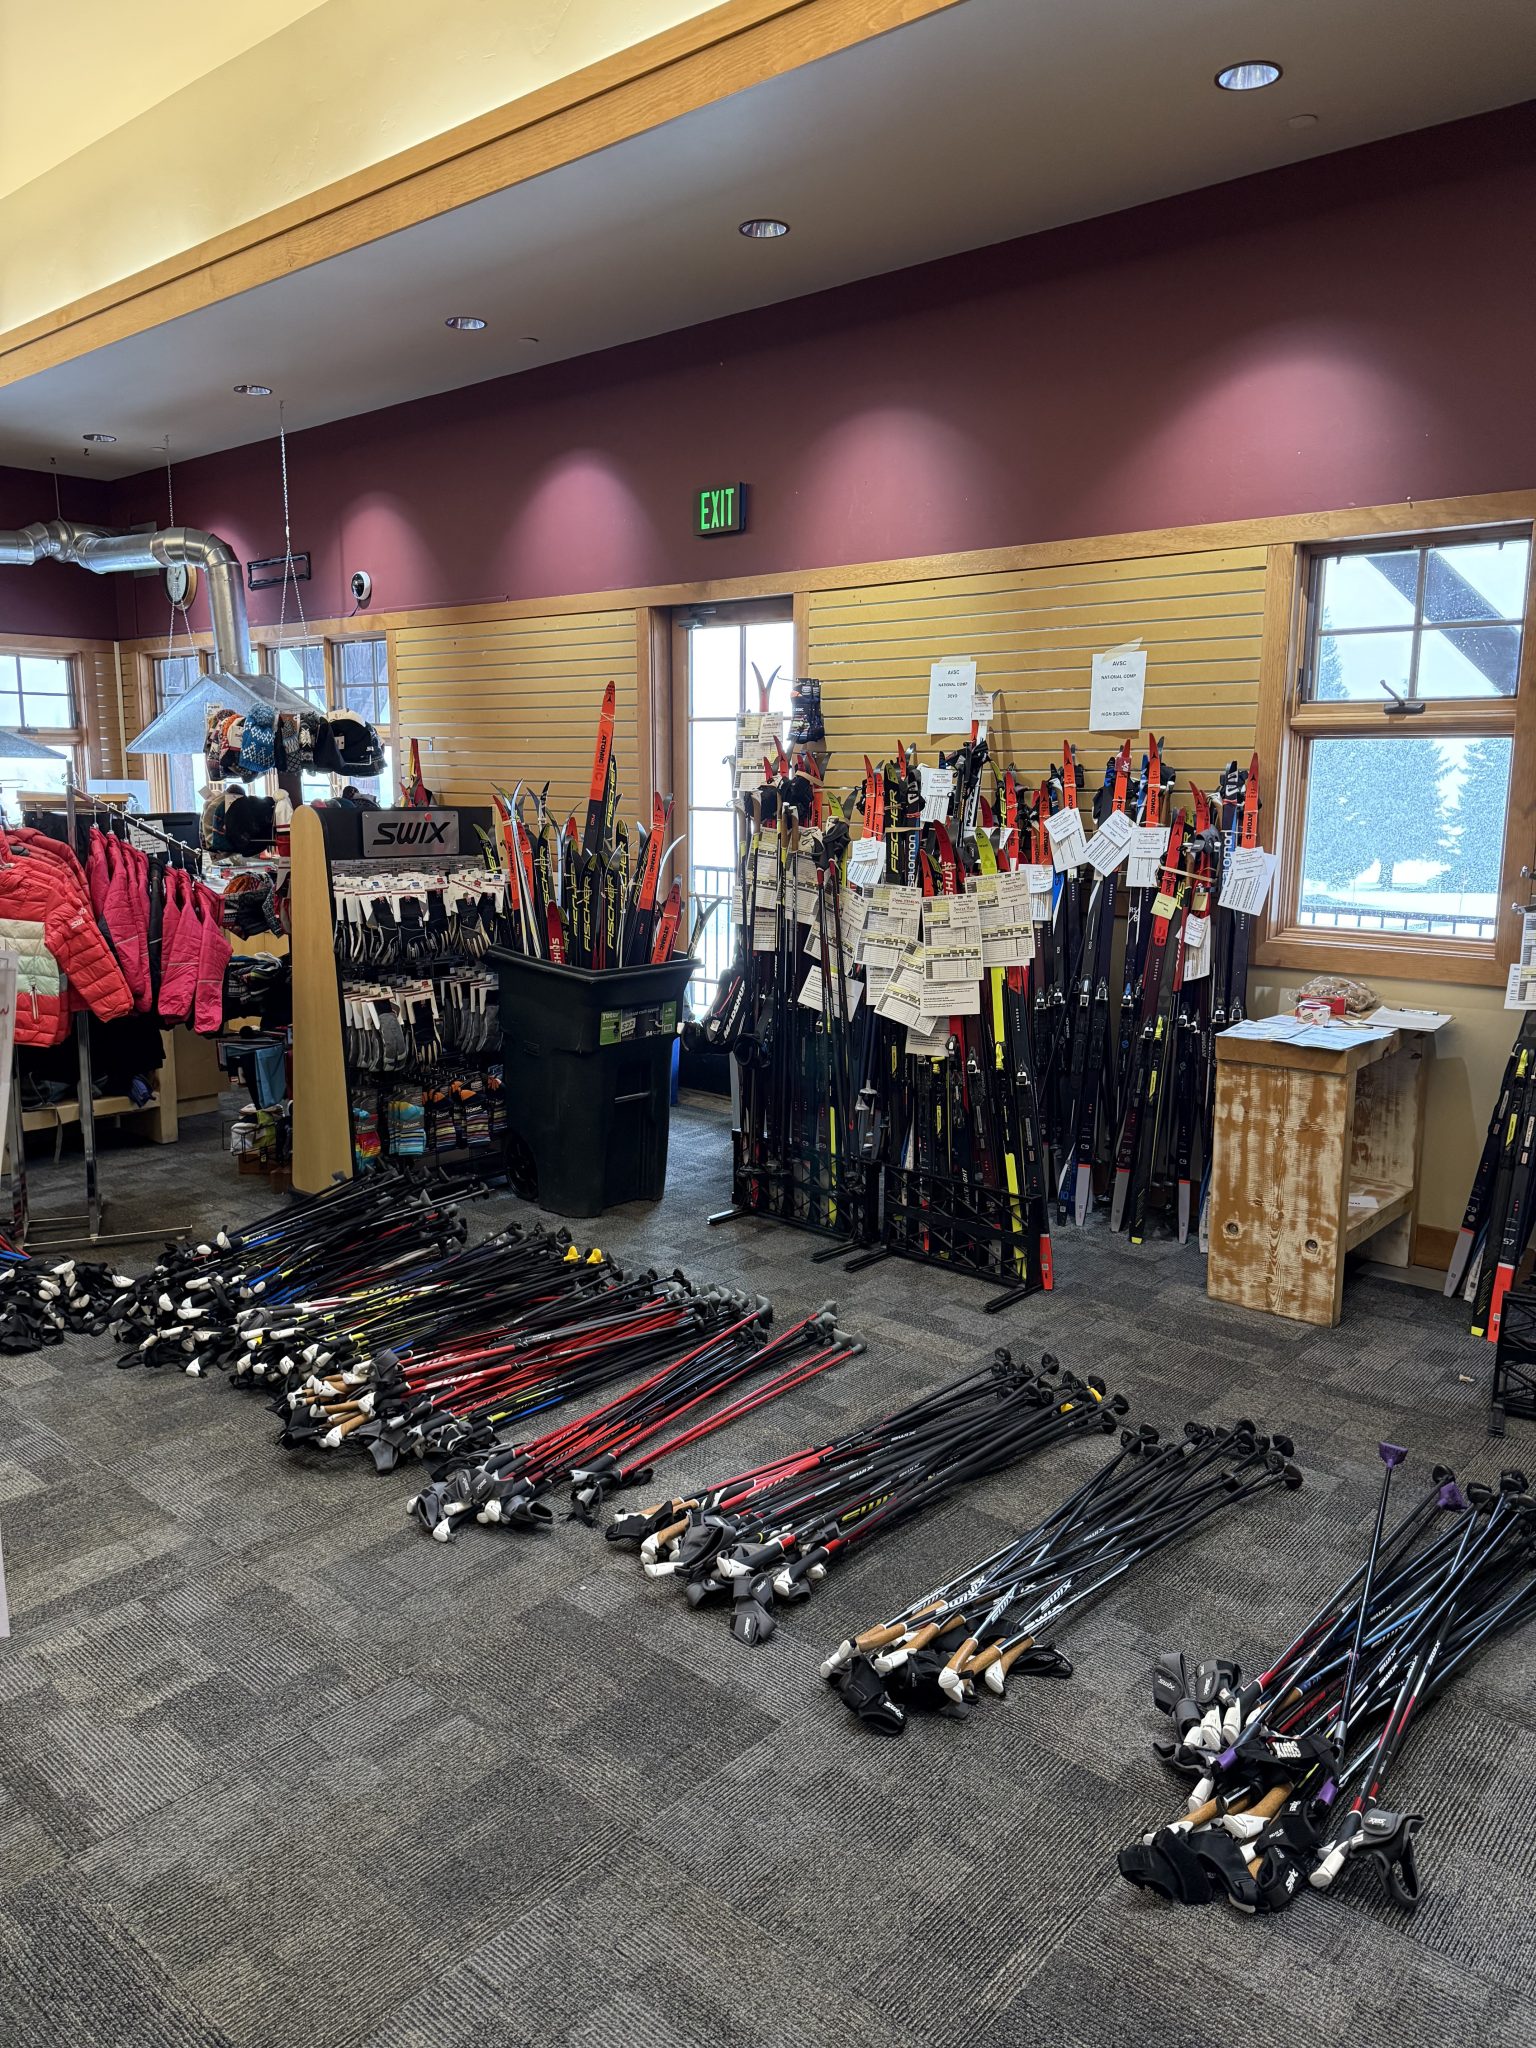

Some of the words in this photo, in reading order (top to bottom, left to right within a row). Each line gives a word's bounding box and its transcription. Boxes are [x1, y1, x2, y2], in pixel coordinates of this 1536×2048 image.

[701, 488, 735, 530] EXIT
[599, 735, 607, 764] ATOMIC
[606, 761, 616, 828] FISCHER
[1150, 789, 1158, 815] ATOMIC
[890, 788, 899, 874] FISCHER
[1246, 812, 1254, 840] ATOMIC
[650, 843, 658, 873] ATOMIC
[908, 834, 917, 888] salomon
[583, 876, 592, 952] FISCHER
[607, 874, 616, 950] FISCHER
[660, 925, 671, 951] ATOMIC
[935, 1592, 980, 1616] SWIX
[1040, 1579, 1073, 1611] SWIX
